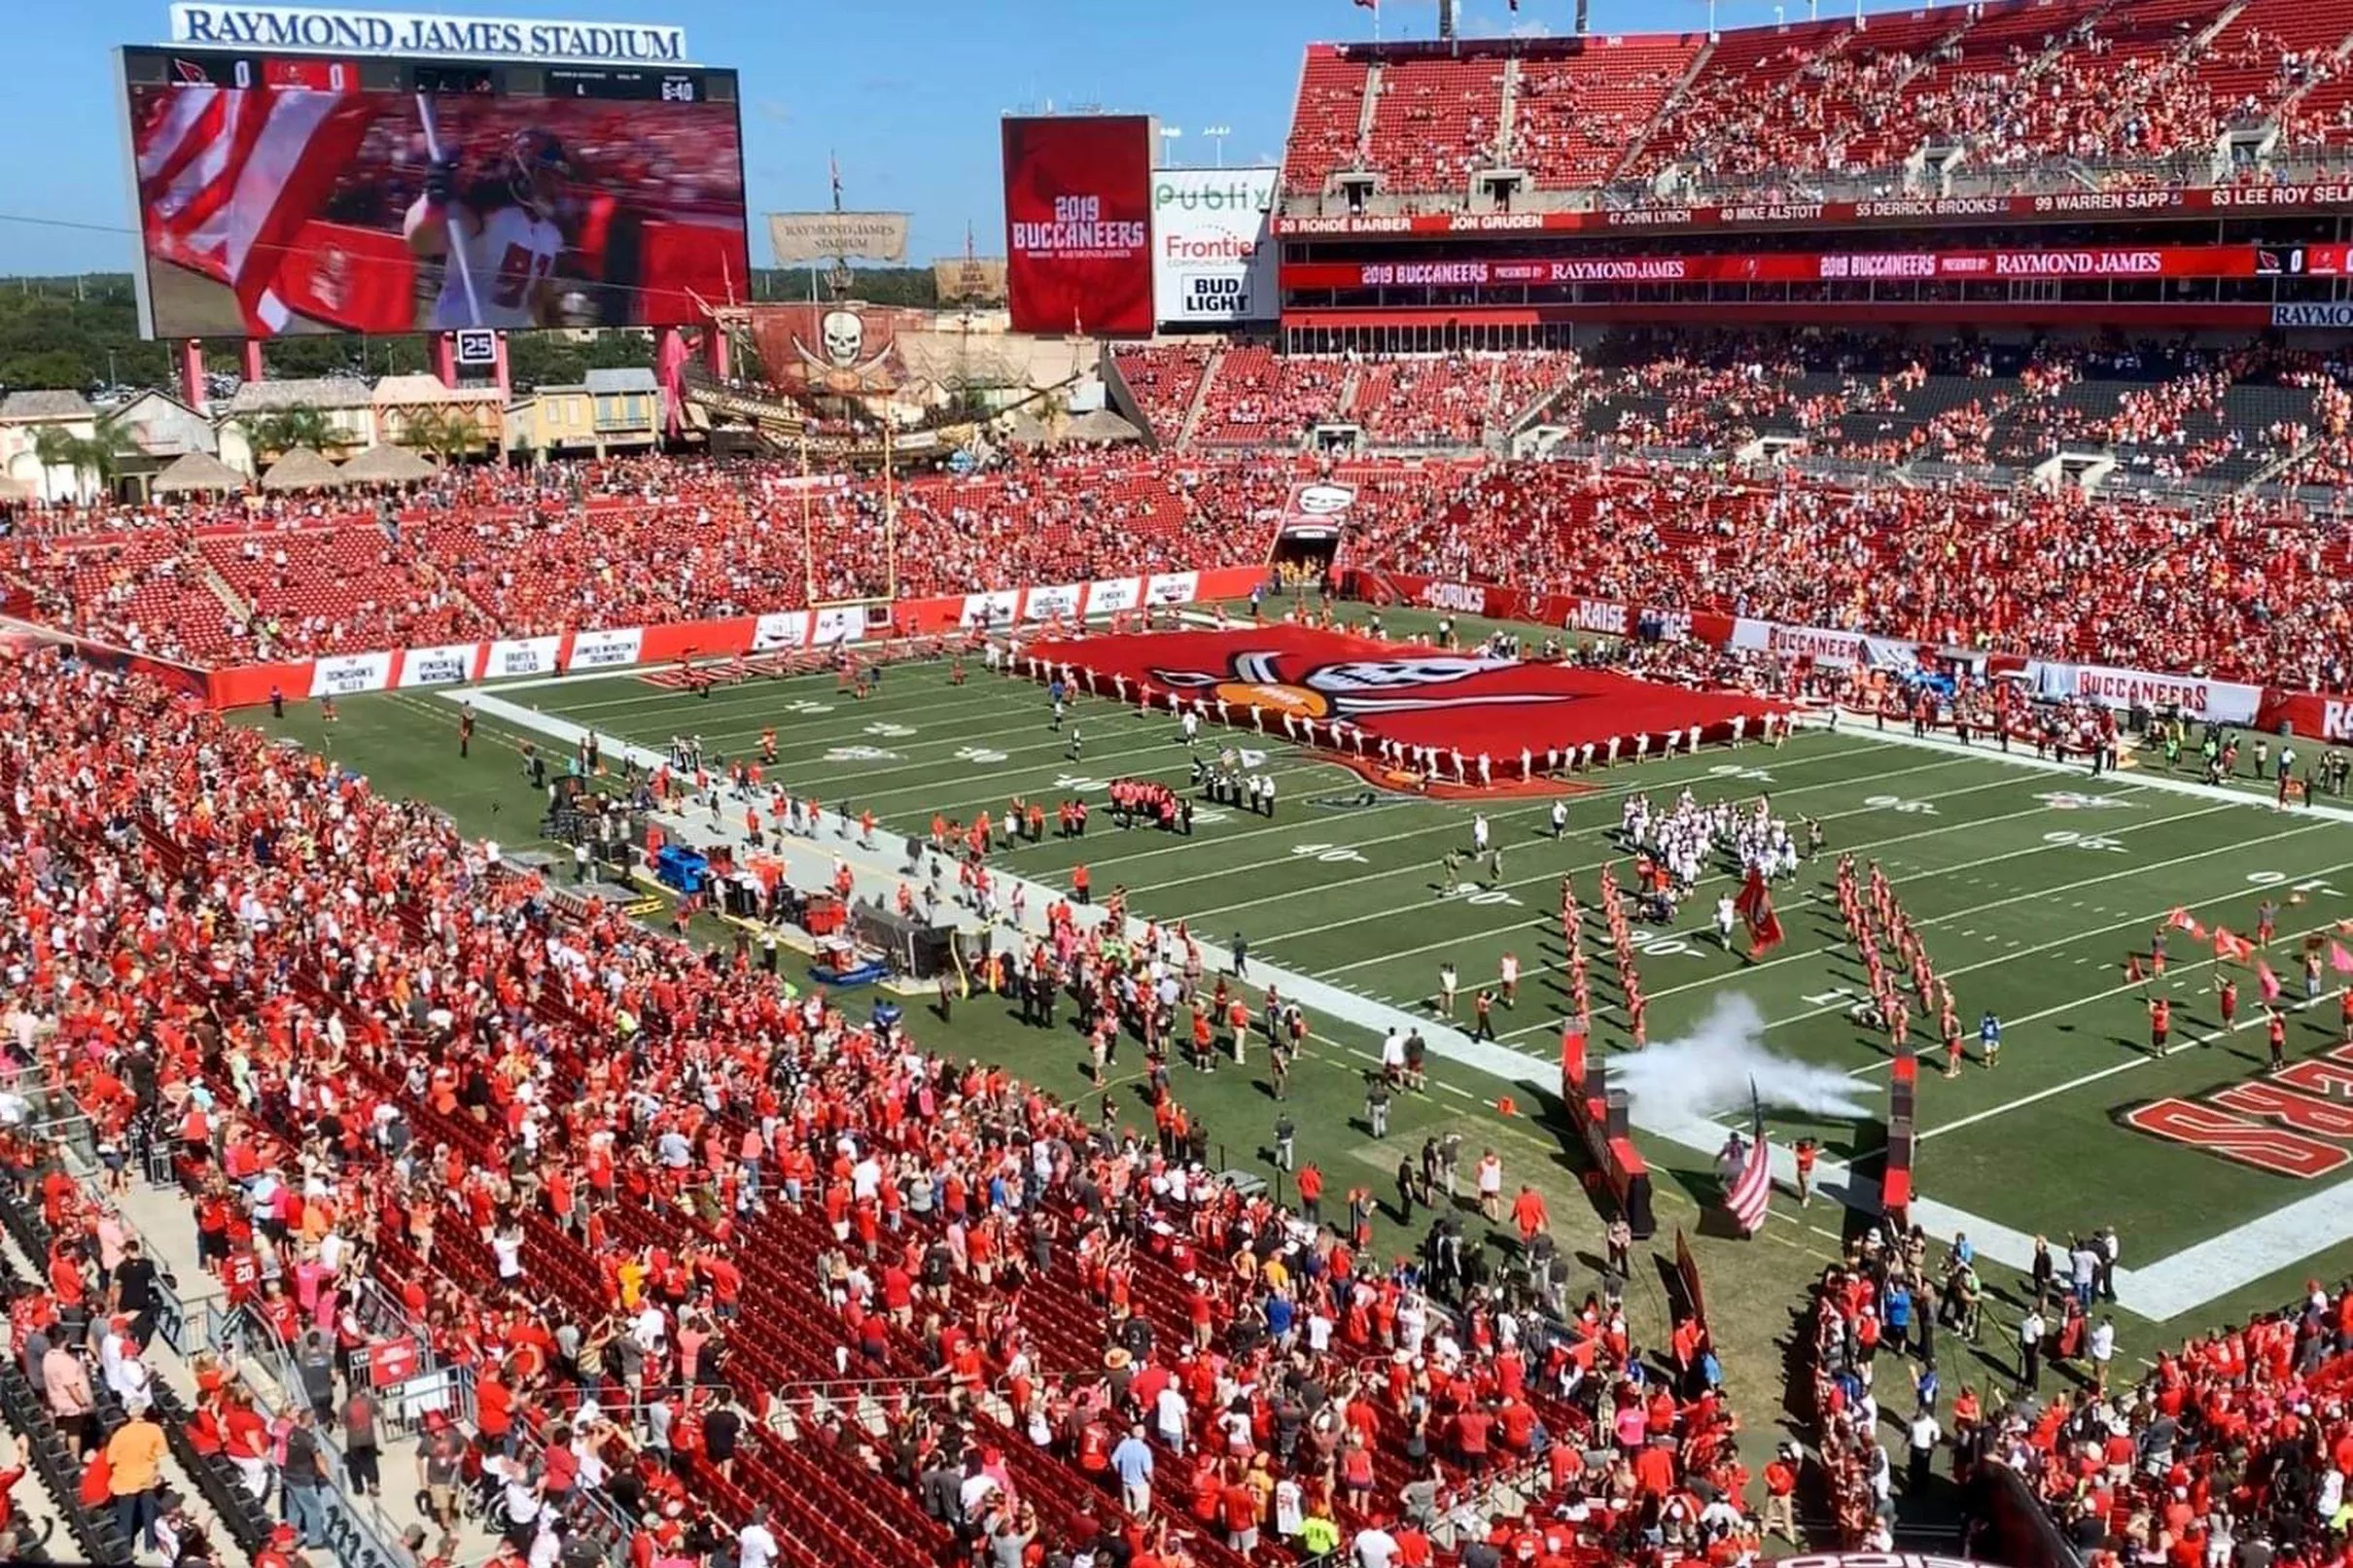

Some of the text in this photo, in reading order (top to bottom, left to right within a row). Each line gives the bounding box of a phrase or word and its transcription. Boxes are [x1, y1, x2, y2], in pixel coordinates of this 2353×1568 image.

[185, 9, 683, 60] RAYMOND JAMES STADIUM
[234, 60, 250, 88] 0
[329, 63, 344, 91] 0
[1155, 182, 1271, 211] Publix
[2035, 191, 2169, 211] 99 WARREN SAPP
[2211, 186, 2353, 205] 63 LEE ROY SEL
[1054, 195, 1100, 222] 2019
[1622, 211, 1651, 225] JOHN
[1654, 209, 1691, 224] LYNCH
[1737, 206, 1765, 221] MIKE
[1767, 204, 1823, 220] ALSTOTT
[1855, 197, 1997, 218] 55 DERRICK BROOKS
[1012, 221, 1144, 249] BUCCANEERS
[1352, 217, 1412, 232] BARBER
[1449, 216, 1478, 231] JON
[1166, 235, 1264, 258] Frontier
[1820, 256, 1848, 277] 2019
[1850, 254, 1937, 277] BUCCANEERS
[1995, 253, 2092, 275] RAYMOND
[2094, 251, 2162, 273] JAMES
[2290, 249, 2303, 273] 0
[1361, 264, 1393, 285] 2019
[1395, 263, 1489, 285] BUCCANEERS
[1551, 261, 1636, 281] RAYMOND
[1637, 261, 1686, 279] JAMES
[1194, 278, 1240, 295] BUD
[1186, 296, 1248, 312] LIGHT
[464, 337, 491, 357] 25
[1580, 600, 1629, 633] RAISE
[2080, 671, 2207, 712] BUCCANEERS
[234, 1264, 255, 1284] 20
